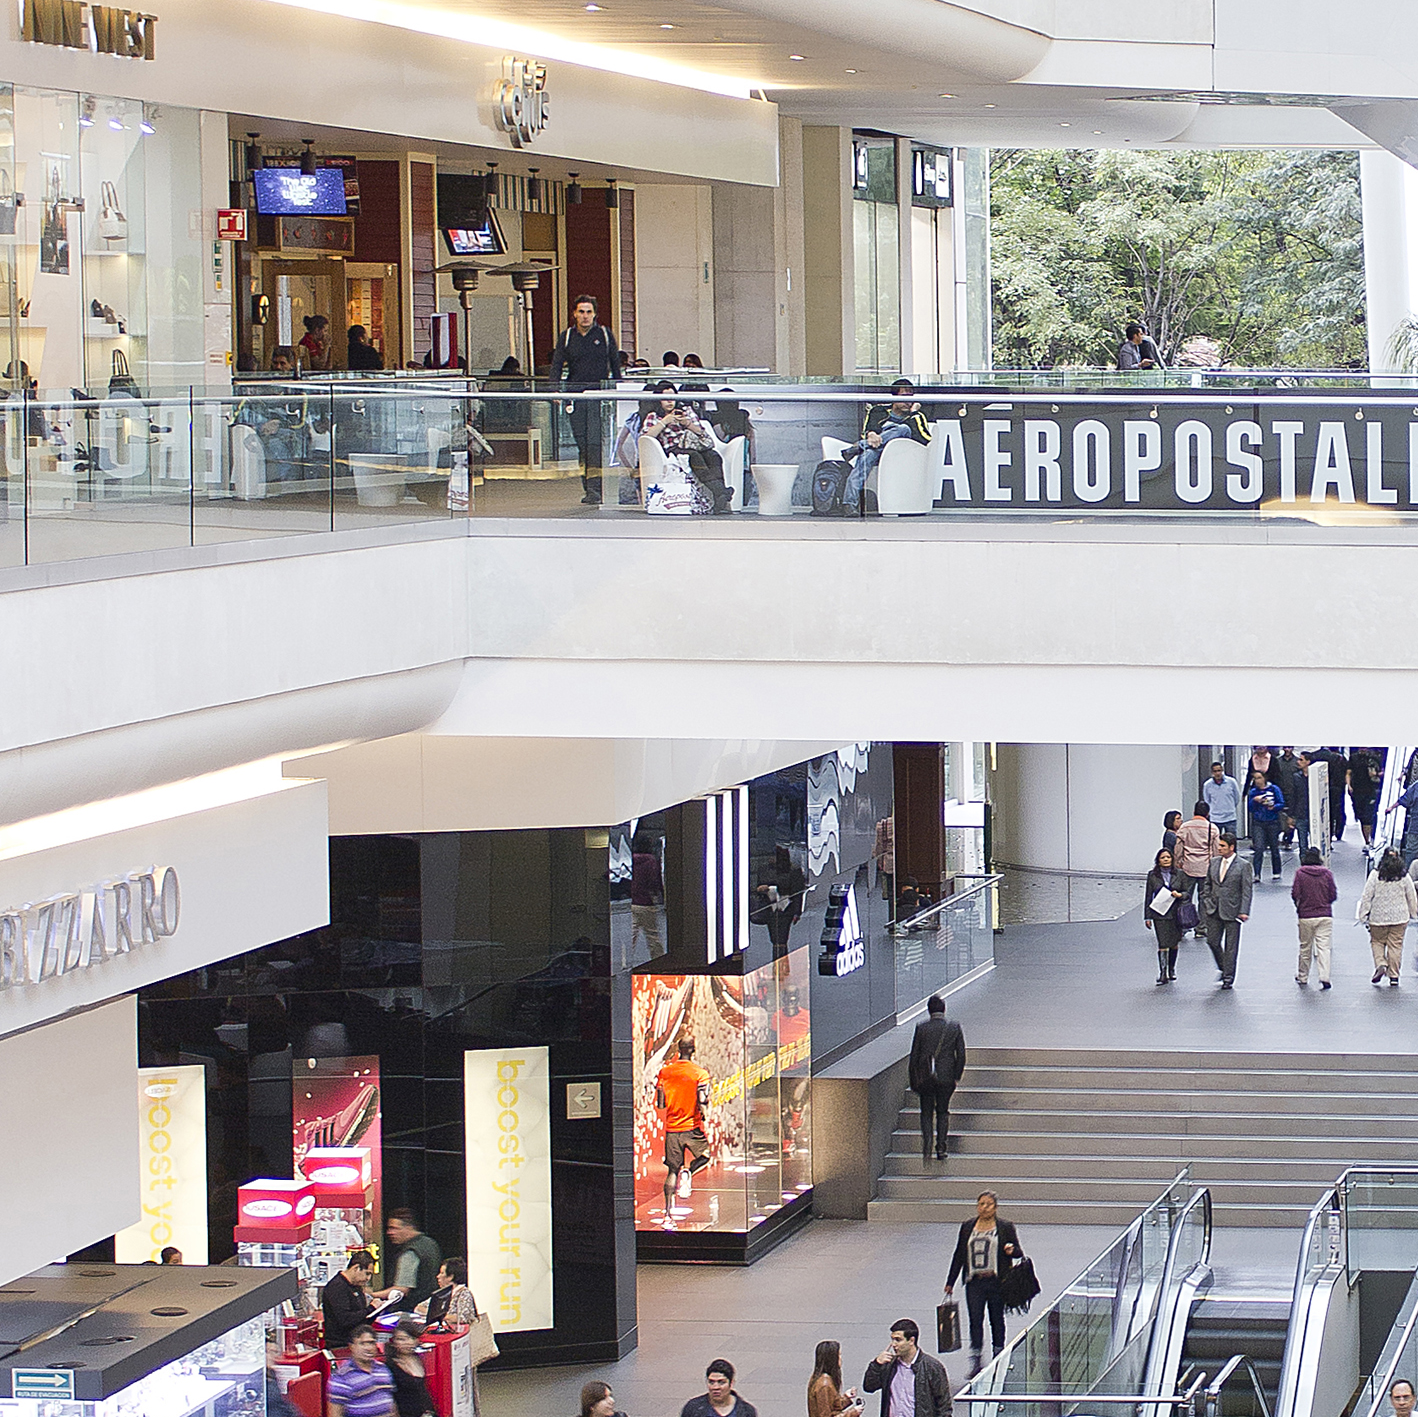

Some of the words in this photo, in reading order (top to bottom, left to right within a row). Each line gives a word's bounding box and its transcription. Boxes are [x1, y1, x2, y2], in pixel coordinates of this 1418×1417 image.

[836, 938, 865, 977] adidas
[497, 1059, 525, 1169] boost
[491, 1178, 520, 1257] your
[499, 1267, 521, 1325] run
